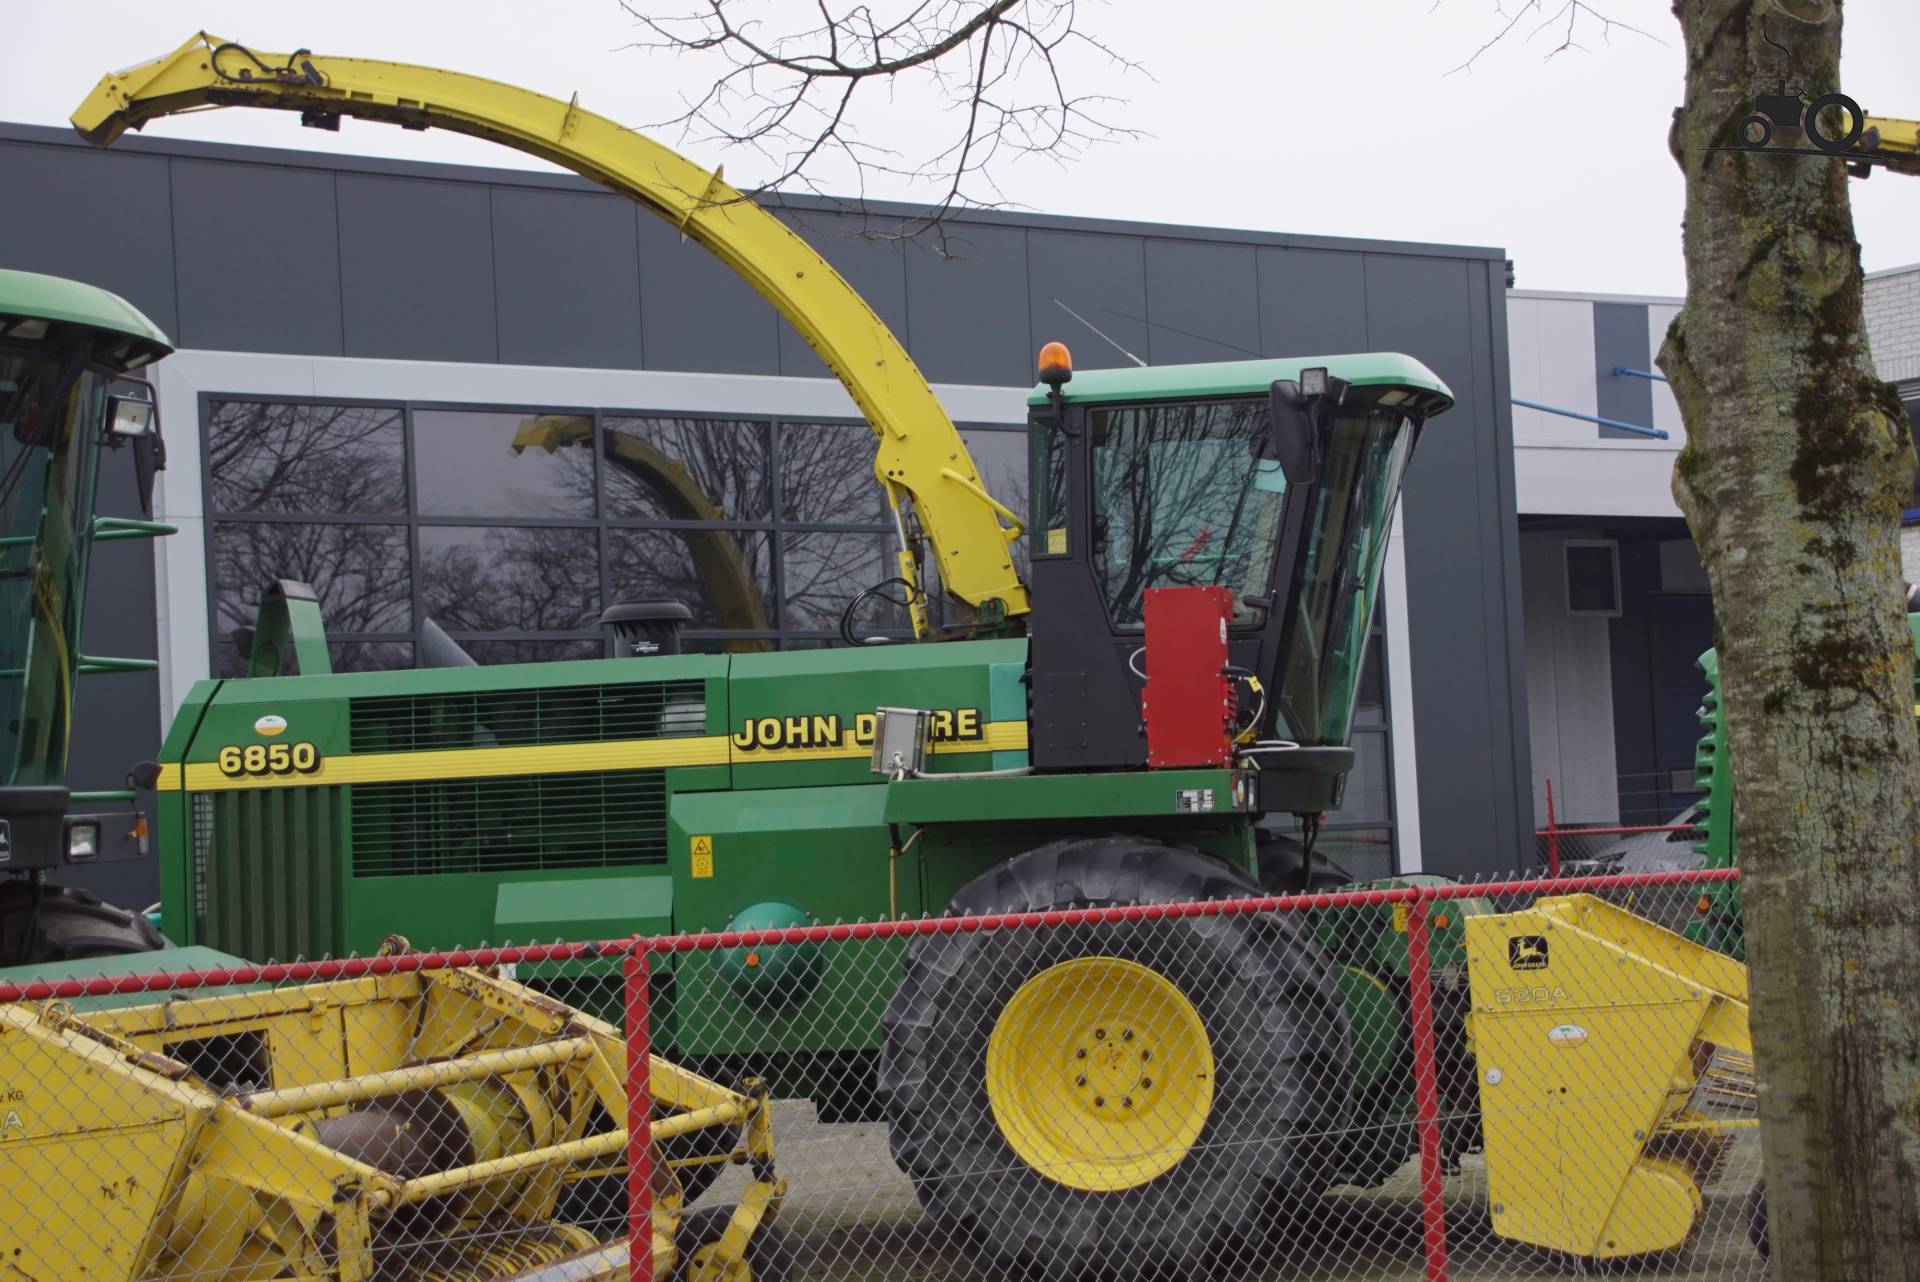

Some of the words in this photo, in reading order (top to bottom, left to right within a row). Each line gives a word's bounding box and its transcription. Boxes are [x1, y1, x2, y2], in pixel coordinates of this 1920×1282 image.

[733, 713, 843, 751] JOHN
[854, 708, 983, 745] DRE
[219, 741, 320, 777] 6850
